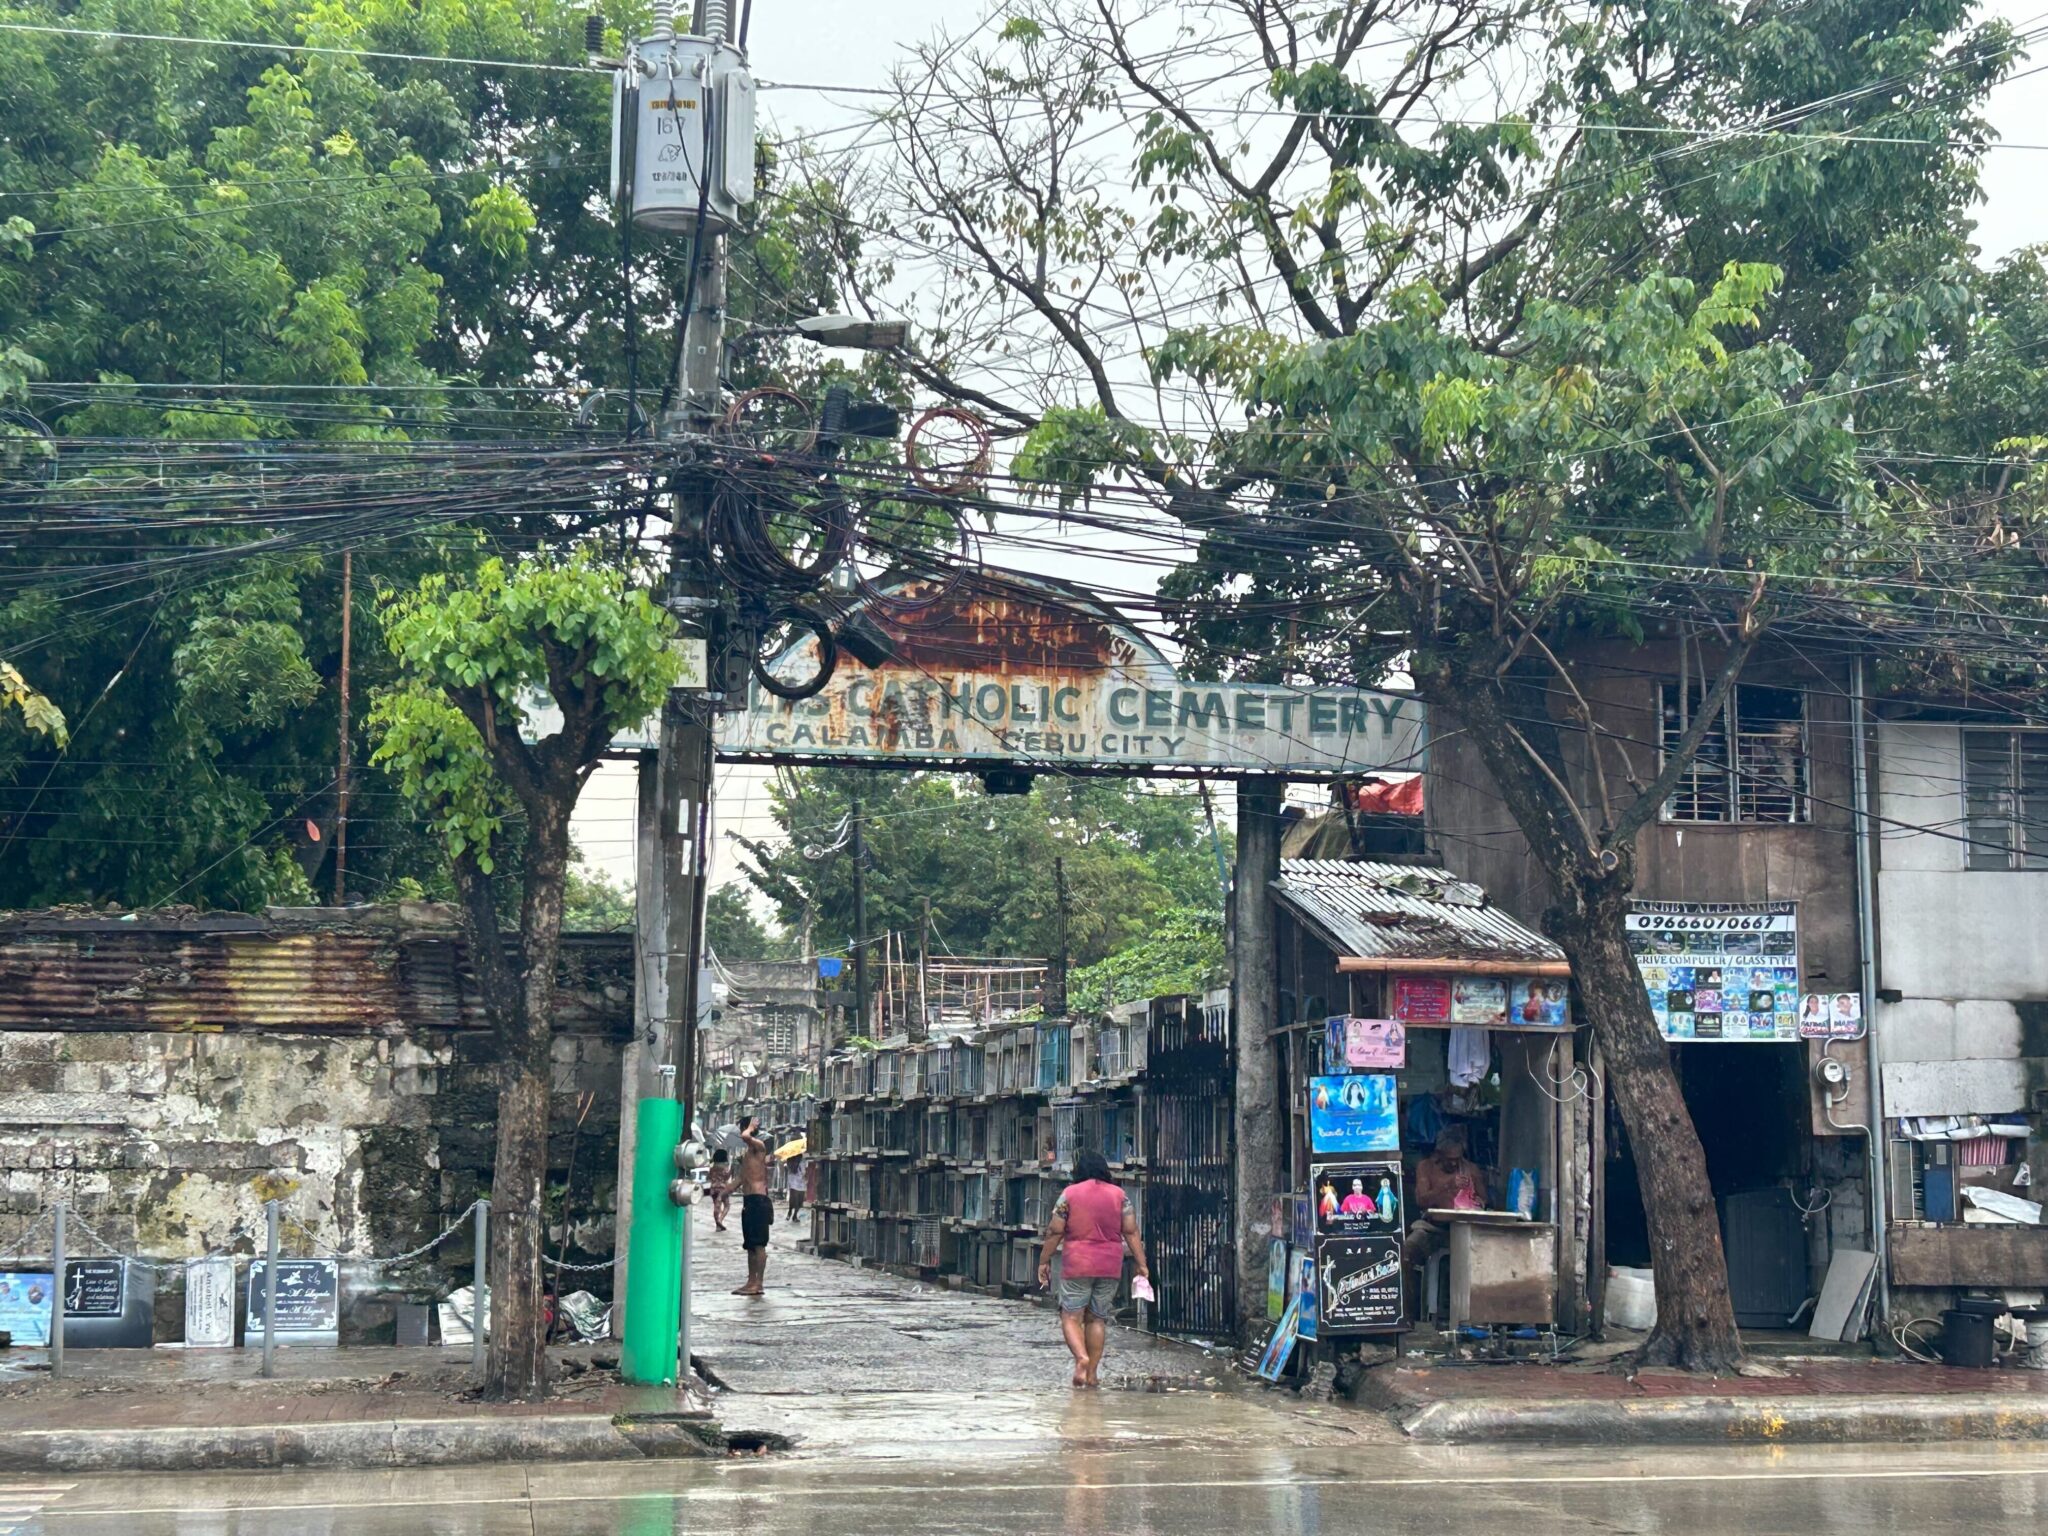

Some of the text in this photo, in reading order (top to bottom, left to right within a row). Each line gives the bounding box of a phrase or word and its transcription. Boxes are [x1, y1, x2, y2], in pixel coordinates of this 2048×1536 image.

[847, 678, 1081, 722] CATHOLIC
[1109, 687, 1405, 735] CEMETERY
[1001, 731, 1087, 754] CEBU
[1101, 734, 1186, 755] CITY
[1638, 916, 1775, 930] 09666070667
[1669, 956, 1727, 966] COMPUTER
[1735, 956, 1766, 966] GLASS
